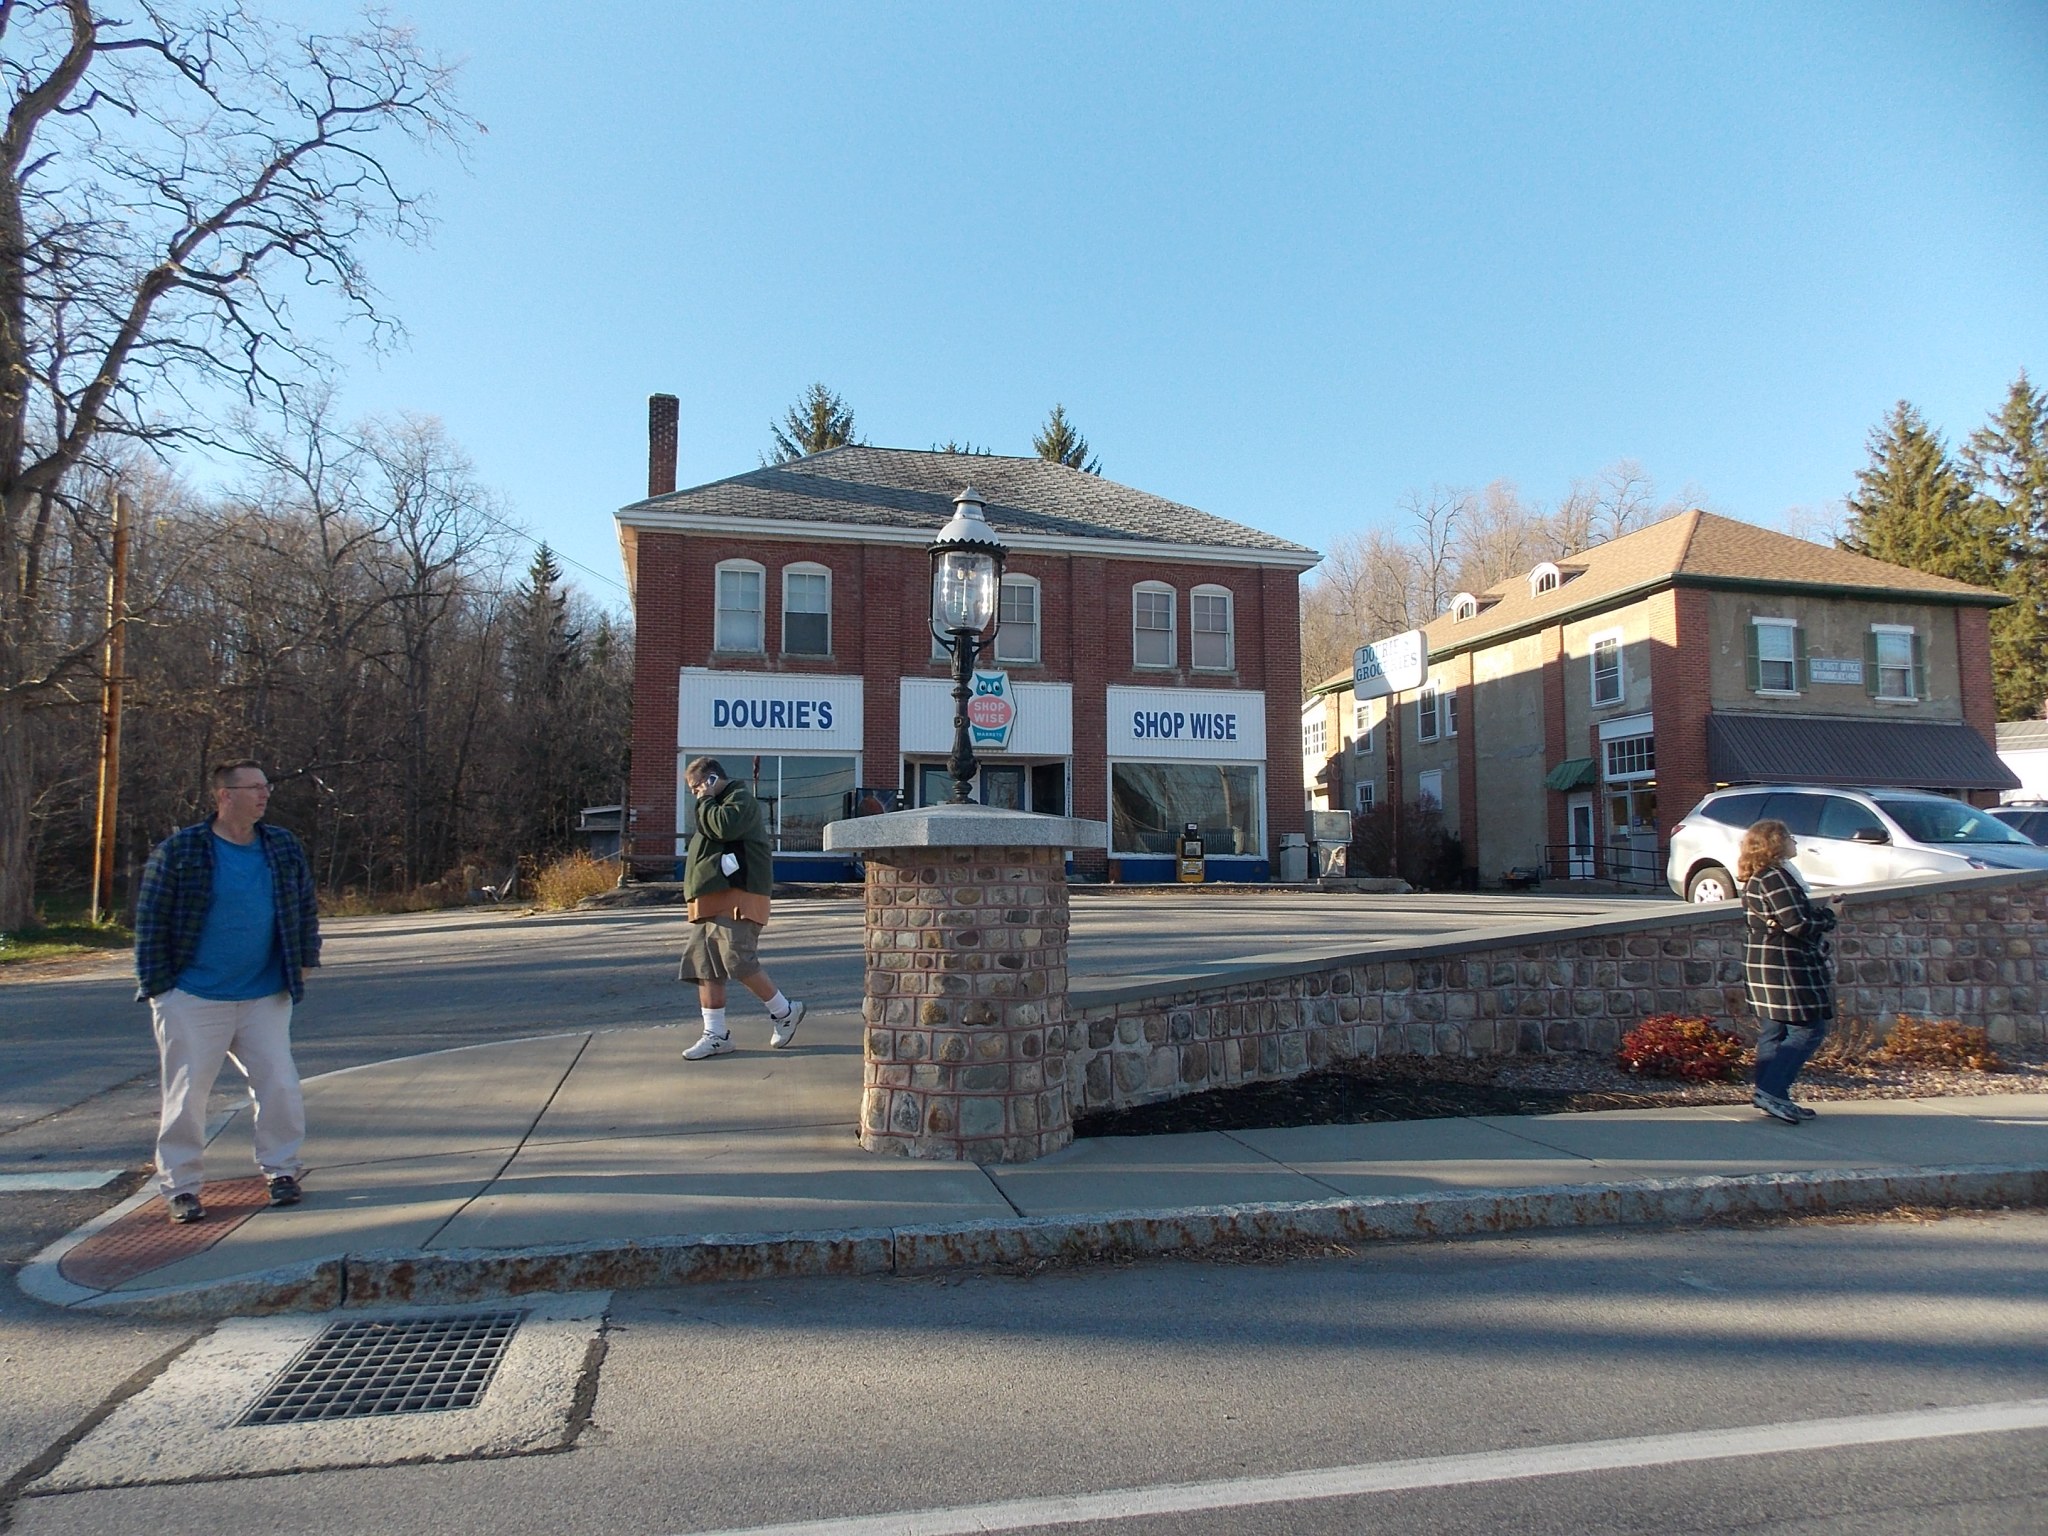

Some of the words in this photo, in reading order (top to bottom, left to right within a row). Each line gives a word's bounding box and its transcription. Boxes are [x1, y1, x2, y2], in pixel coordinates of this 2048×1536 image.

[1361, 637, 1409, 665] DOURI
[1356, 652, 1418, 682] GROCES
[713, 699, 833, 729] DOURIE'S
[974, 701, 1005, 712] SHOP
[974, 713, 1005, 724] WISE
[1133, 711, 1185, 739] SHOP
[1190, 712, 1237, 740] WISE
